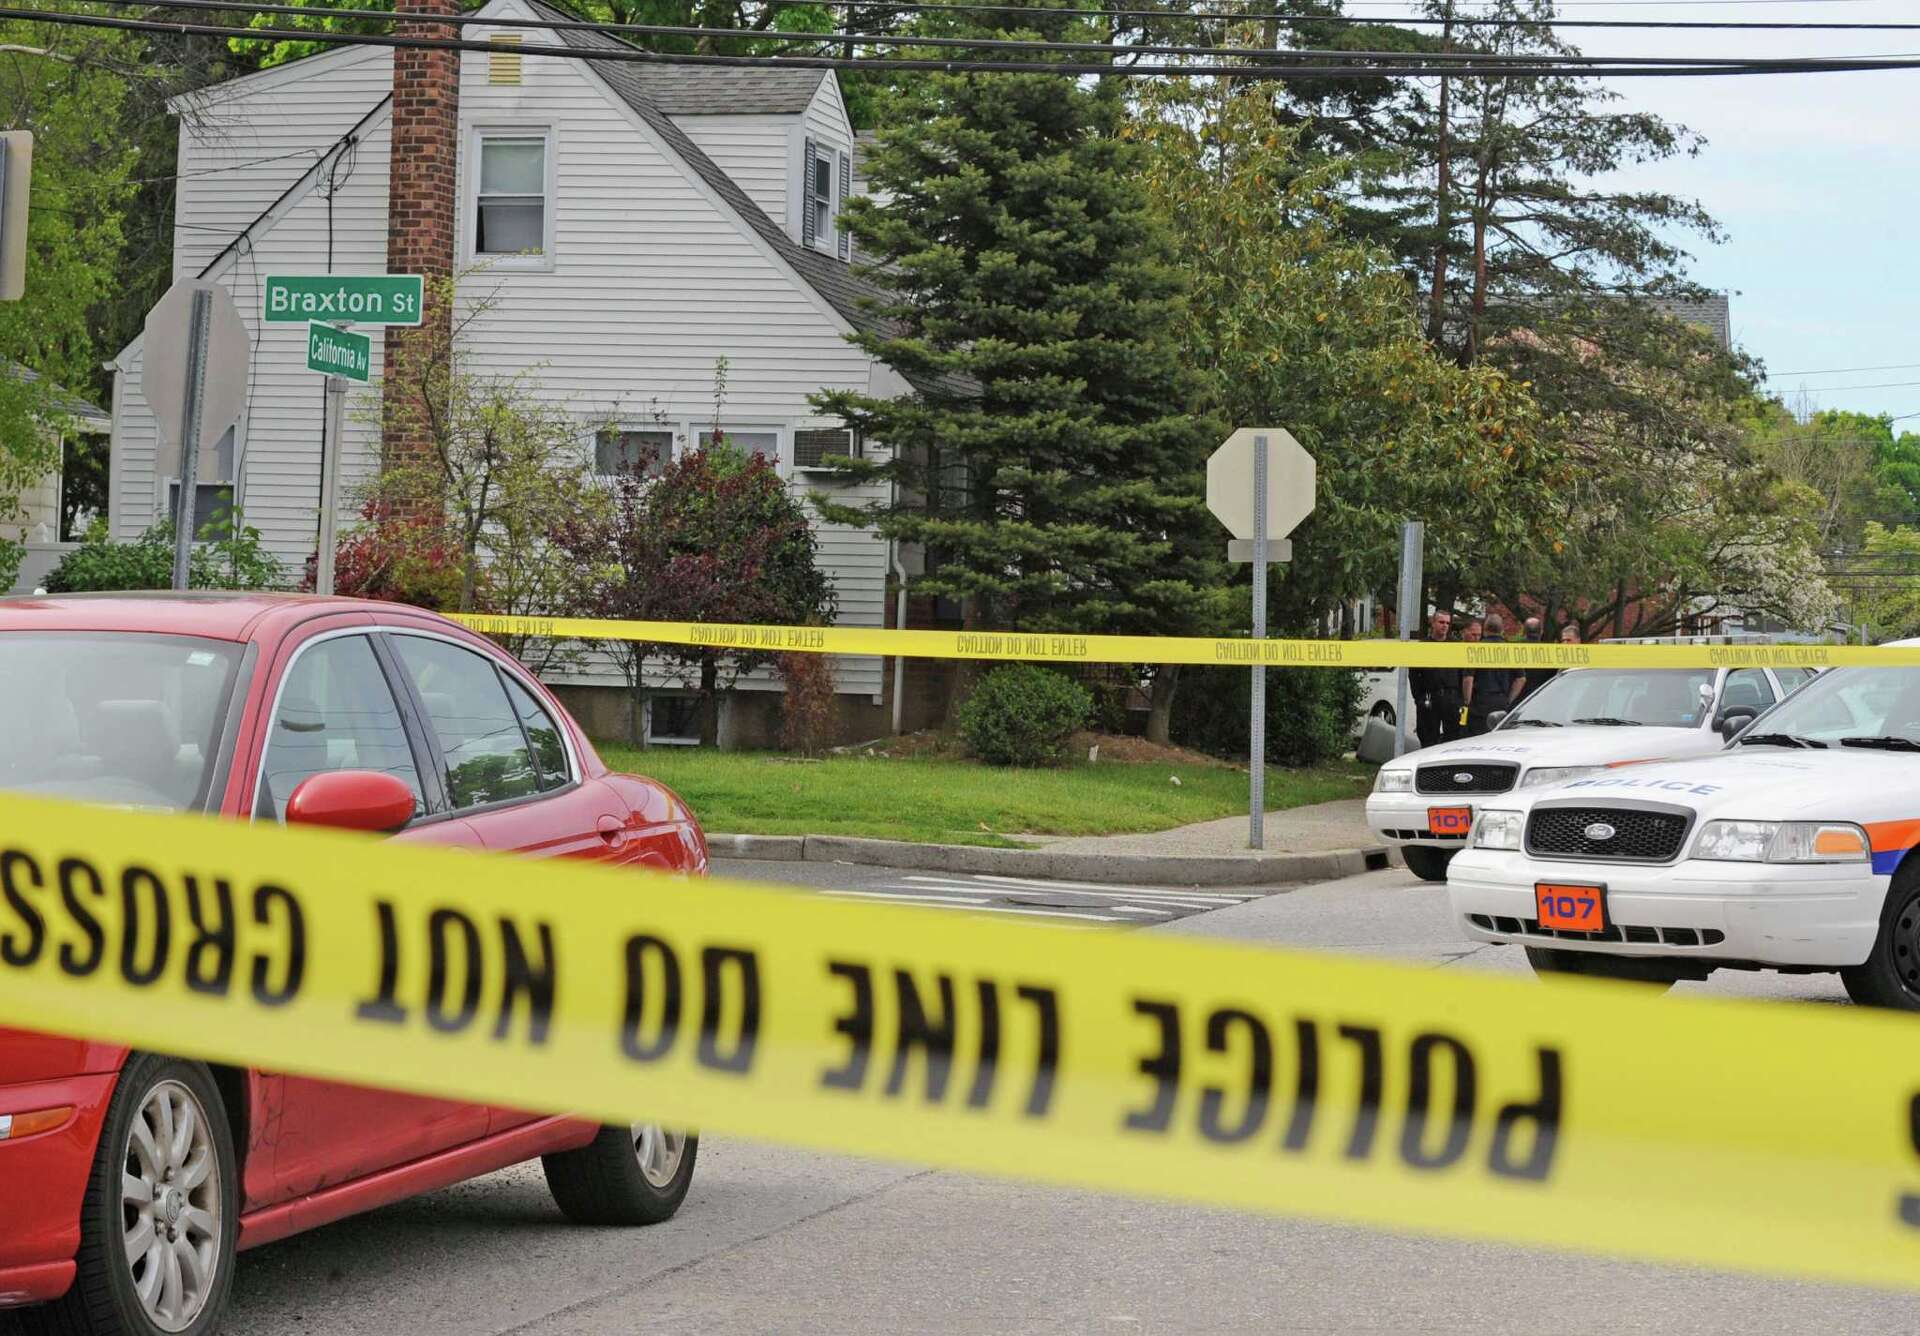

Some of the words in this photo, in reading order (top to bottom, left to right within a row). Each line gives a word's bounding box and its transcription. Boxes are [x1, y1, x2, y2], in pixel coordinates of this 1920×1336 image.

[271, 286, 382, 313] Braxton
[392, 292, 415, 313] St
[311, 334, 355, 367] California
[357, 352, 367, 371] Av
[1434, 814, 1469, 827] 101
[1562, 778, 1724, 796] POLICE
[0, 848, 306, 1006] CROSS
[1542, 895, 1596, 919] 107
[354, 898, 557, 1046] NOT
[617, 931, 762, 1075] DO
[820, 959, 1061, 1118] LINE
[1120, 998, 1565, 1183] POLICE
